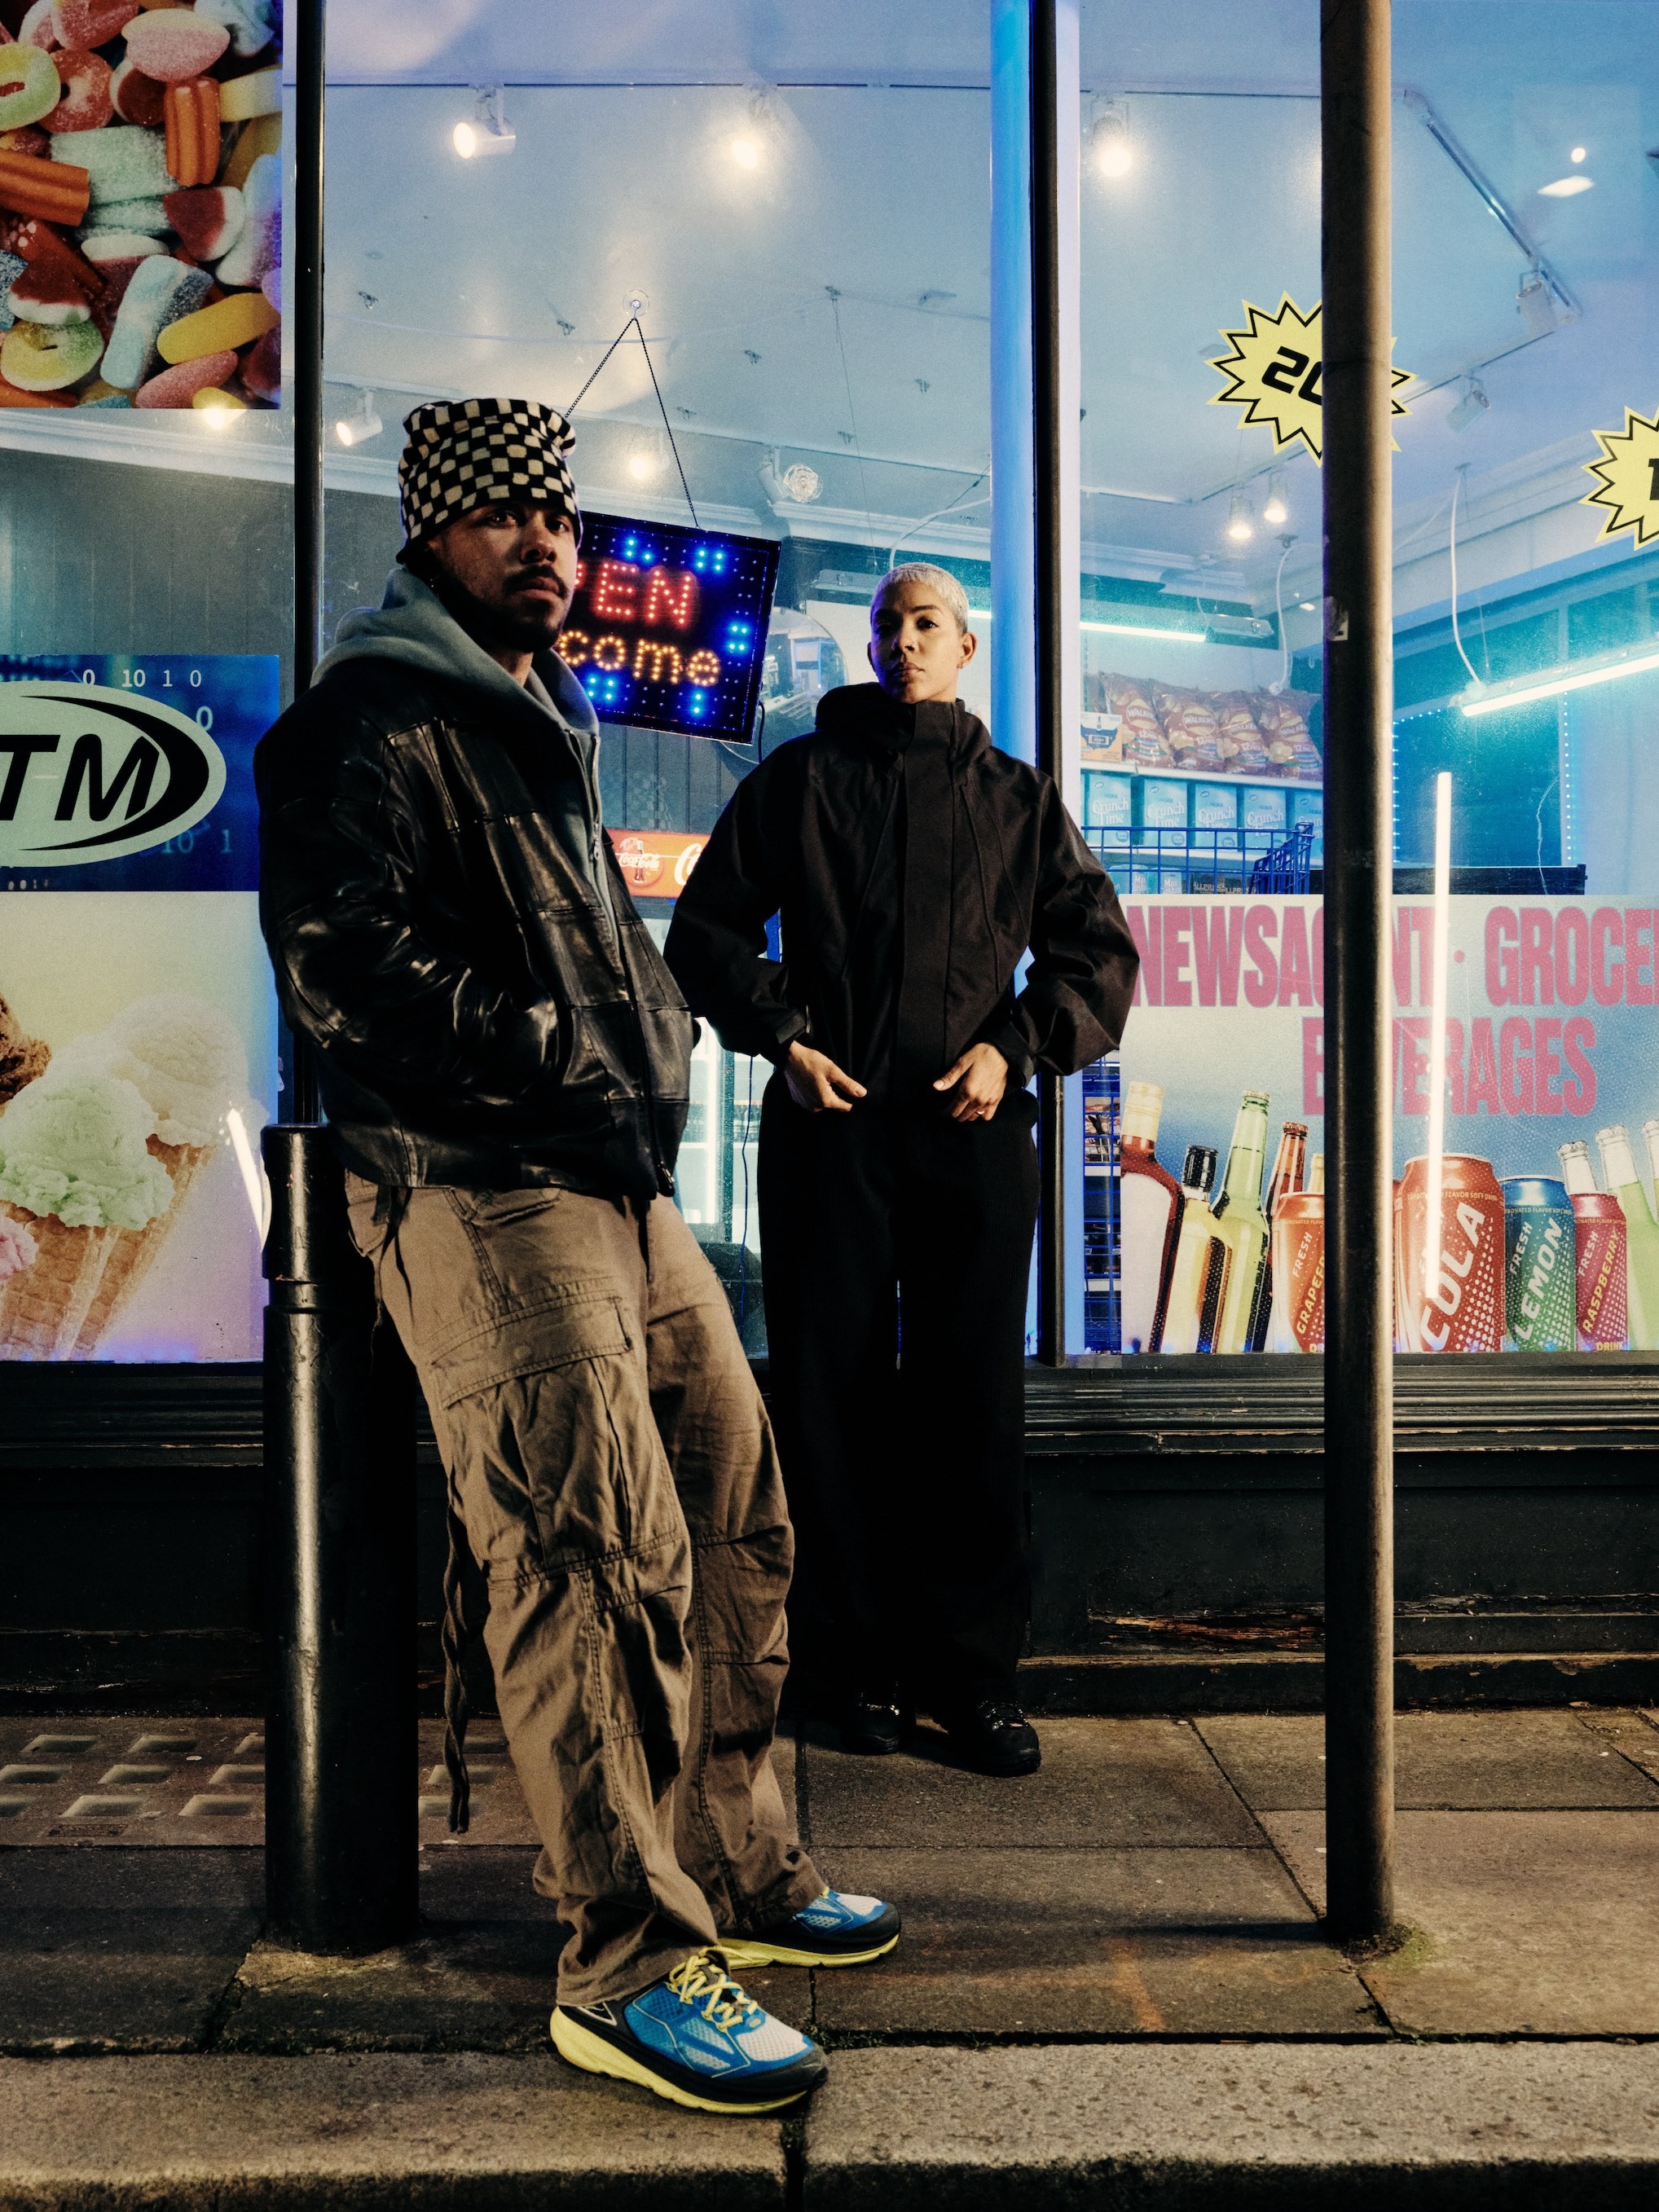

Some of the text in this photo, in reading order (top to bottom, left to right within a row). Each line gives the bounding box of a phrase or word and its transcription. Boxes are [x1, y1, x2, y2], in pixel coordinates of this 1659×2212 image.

[122, 669, 147, 688] 10
[189, 670, 203, 688] 0
[557, 629, 721, 688] come
[196, 706, 213, 732] 0
[0, 733, 160, 821] TM
[1092, 798, 1129, 814] Crunch
[1098, 813, 1124, 825] Time
[1146, 802, 1185, 819] Crunch
[1198, 807, 1234, 824] Crunch
[1246, 809, 1284, 827] Crunch
[1126, 905, 1659, 1008] NEWSANT GROCE
[1303, 1017, 1598, 1116] BERAGES
[1292, 1232, 1314, 1278] FRESH
[1509, 1221, 1533, 1274] FRESH
[1578, 1231, 1599, 1277] FRESH
[1419, 1201, 1485, 1351] COLA
[1514, 1217, 1563, 1340] LEMON
[1582, 1227, 1619, 1333] RASPBERRY
